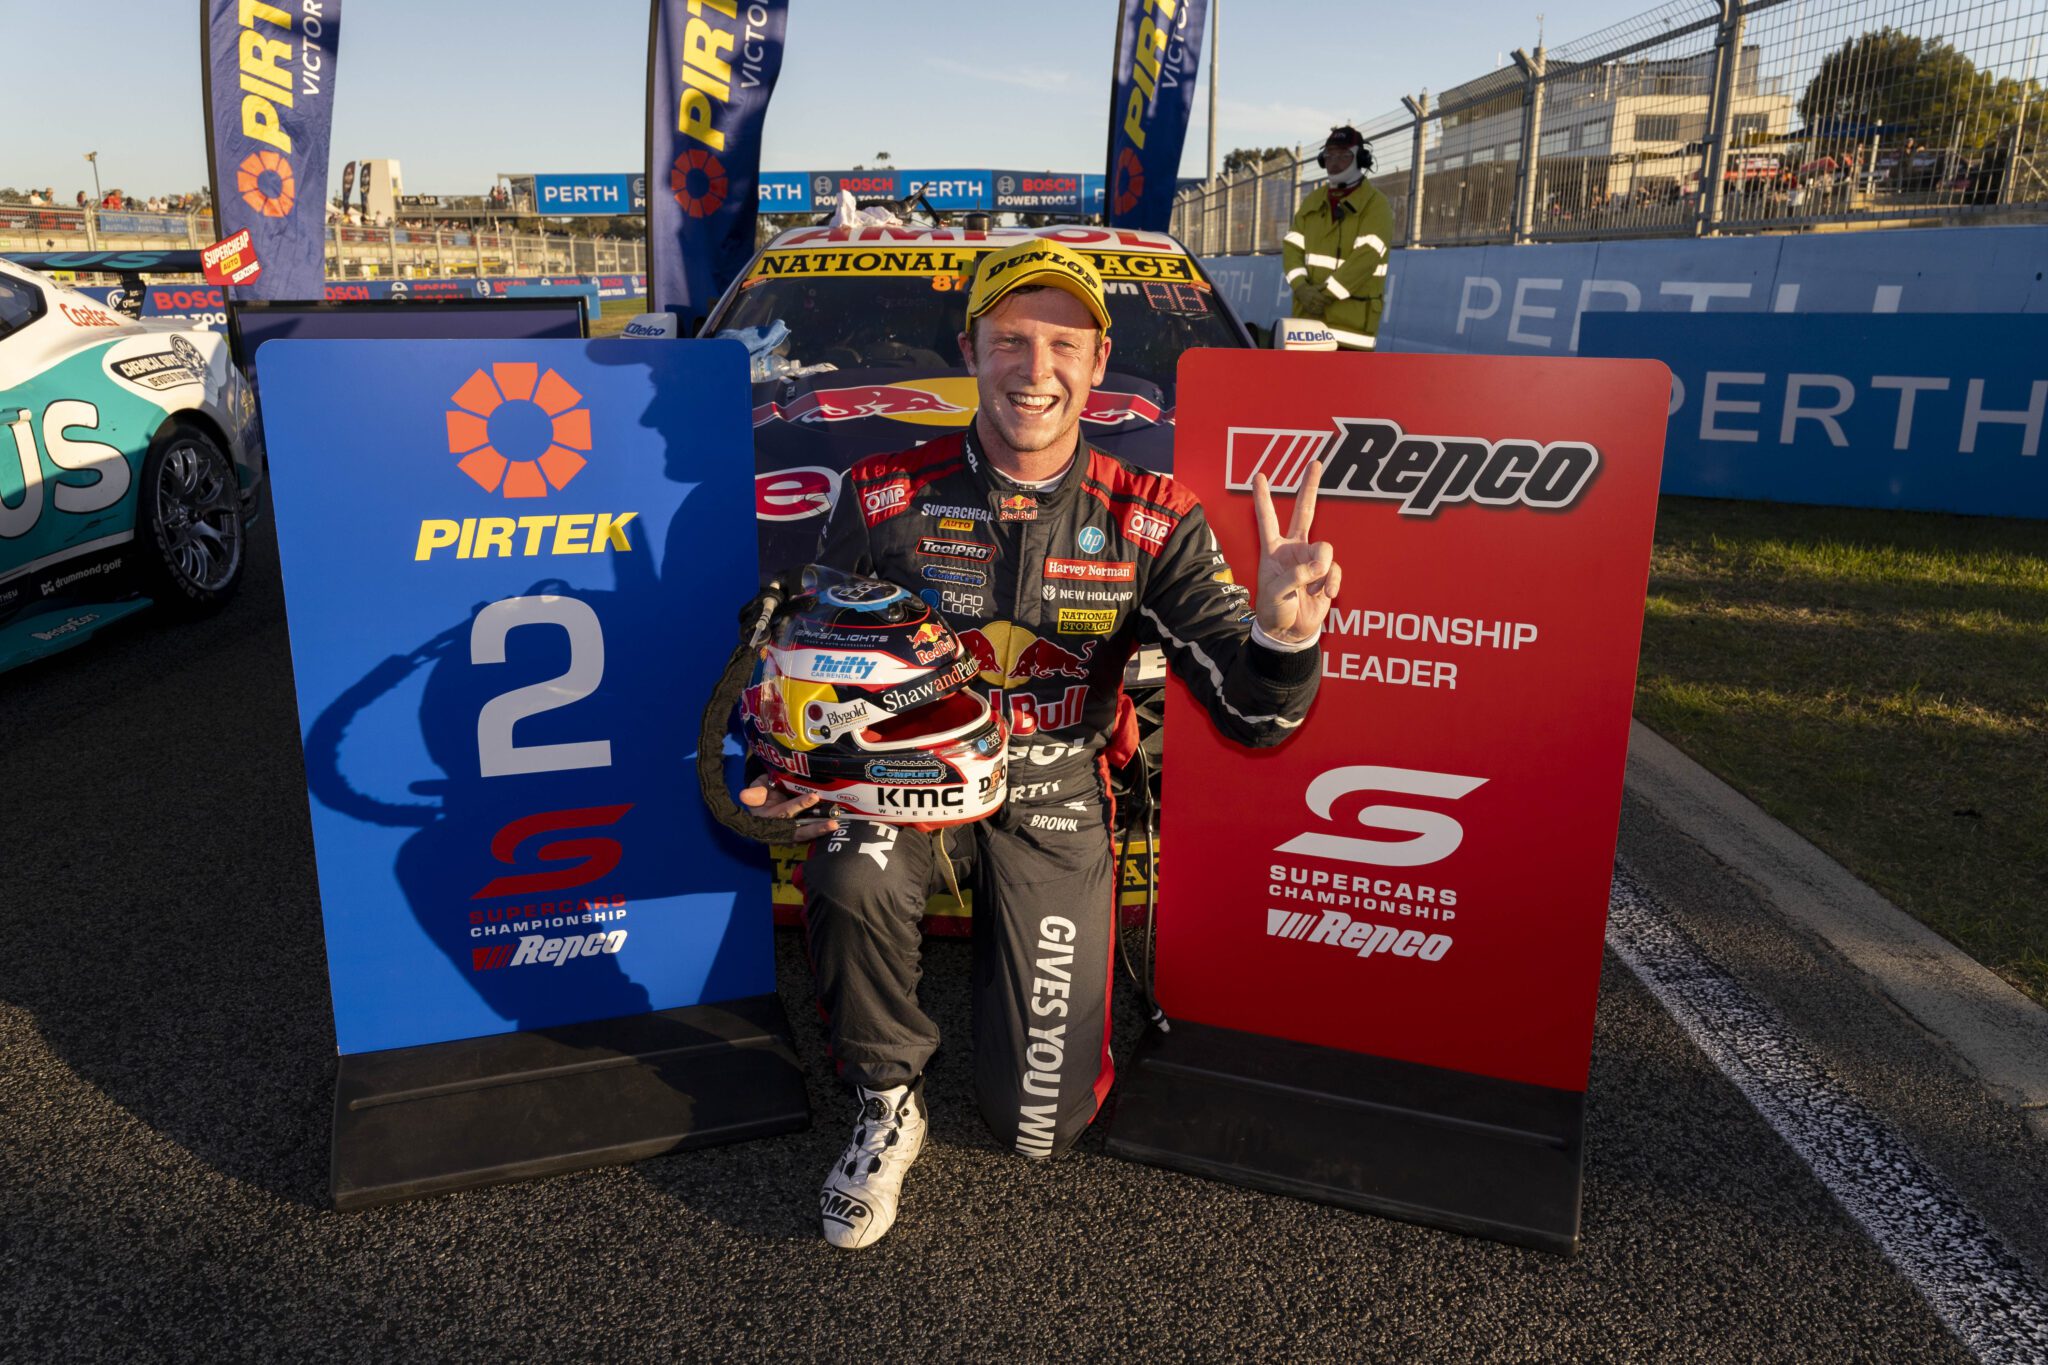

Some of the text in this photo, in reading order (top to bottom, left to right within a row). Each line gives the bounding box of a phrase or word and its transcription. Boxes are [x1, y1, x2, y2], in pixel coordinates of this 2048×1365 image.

[302, 0, 323, 95] VICTOR
[740, 0, 770, 89] VICTO
[239, 0, 293, 154] PIRT
[679, 0, 738, 152] PIRT
[1124, 0, 1176, 150] PIRT
[544, 186, 618, 202] PERTH
[758, 184, 802, 199] RTH
[839, 178, 893, 192] BOSCH
[909, 181, 983, 197] PERTH
[1022, 178, 1076, 192] BOSCH
[998, 195, 1077, 206] POWER TOOLS
[203, 230, 249, 269] SUPERCHEAP
[223, 257, 239, 270] AUTO
[758, 252, 963, 275] NATIONAL
[986, 250, 1098, 290] DUNLOP
[325, 285, 370, 301] OSCH
[931, 275, 969, 292] 87
[152, 289, 225, 311] BOSC
[60, 303, 121, 328] Coates
[119, 356, 165, 378] CHEMICAL
[1671, 371, 2048, 456] ERTH
[1319, 416, 1600, 516] Repco
[865, 487, 906, 511] OMP
[943, 519, 971, 529] AUTO
[1000, 510, 1038, 520] Red Bull
[1129, 514, 1169, 541] OMP
[414, 512, 640, 562] PIRTEK
[1081, 526, 1102, 554] hp
[55, 557, 123, 589] drummond golf
[1048, 561, 1130, 578] Harvey Norman
[941, 590, 984, 608] QUAD
[1059, 589, 1134, 602] NEW HOLLAND
[941, 601, 984, 618] LOCK
[1061, 611, 1114, 621] NATIONAL
[1062, 621, 1112, 632] STORAGE
[1320, 607, 1539, 651] MPIONSHIP
[915, 634, 957, 666] Red Bull
[811, 654, 878, 680] Thrifty
[826, 672, 853, 680] RENTAL
[1321, 652, 1459, 691] LEADER
[470, 594, 613, 779] 2
[826, 702, 868, 726] Blygold
[1008, 685, 1090, 737] Bull
[985, 730, 999, 743] QUAD
[765, 742, 811, 778] Bull
[871, 764, 939, 779] COMPLETE
[878, 808, 964, 817] WHEELS
[1029, 814, 1078, 833] BROWN
[827, 821, 851, 854] uels
[1269, 864, 1458, 907] SUPERCARS
[469, 893, 627, 926] SUPERCARS
[1268, 884, 1457, 922] CHAMPIONSHIP
[470, 909, 628, 938] CHAMPIONSHIP
[1306, 909, 1454, 962] Repco
[509, 929, 628, 967] Repco
[1015, 915, 1077, 1159] GIVES YOU WIN
[820, 1191, 867, 1220] OMP
